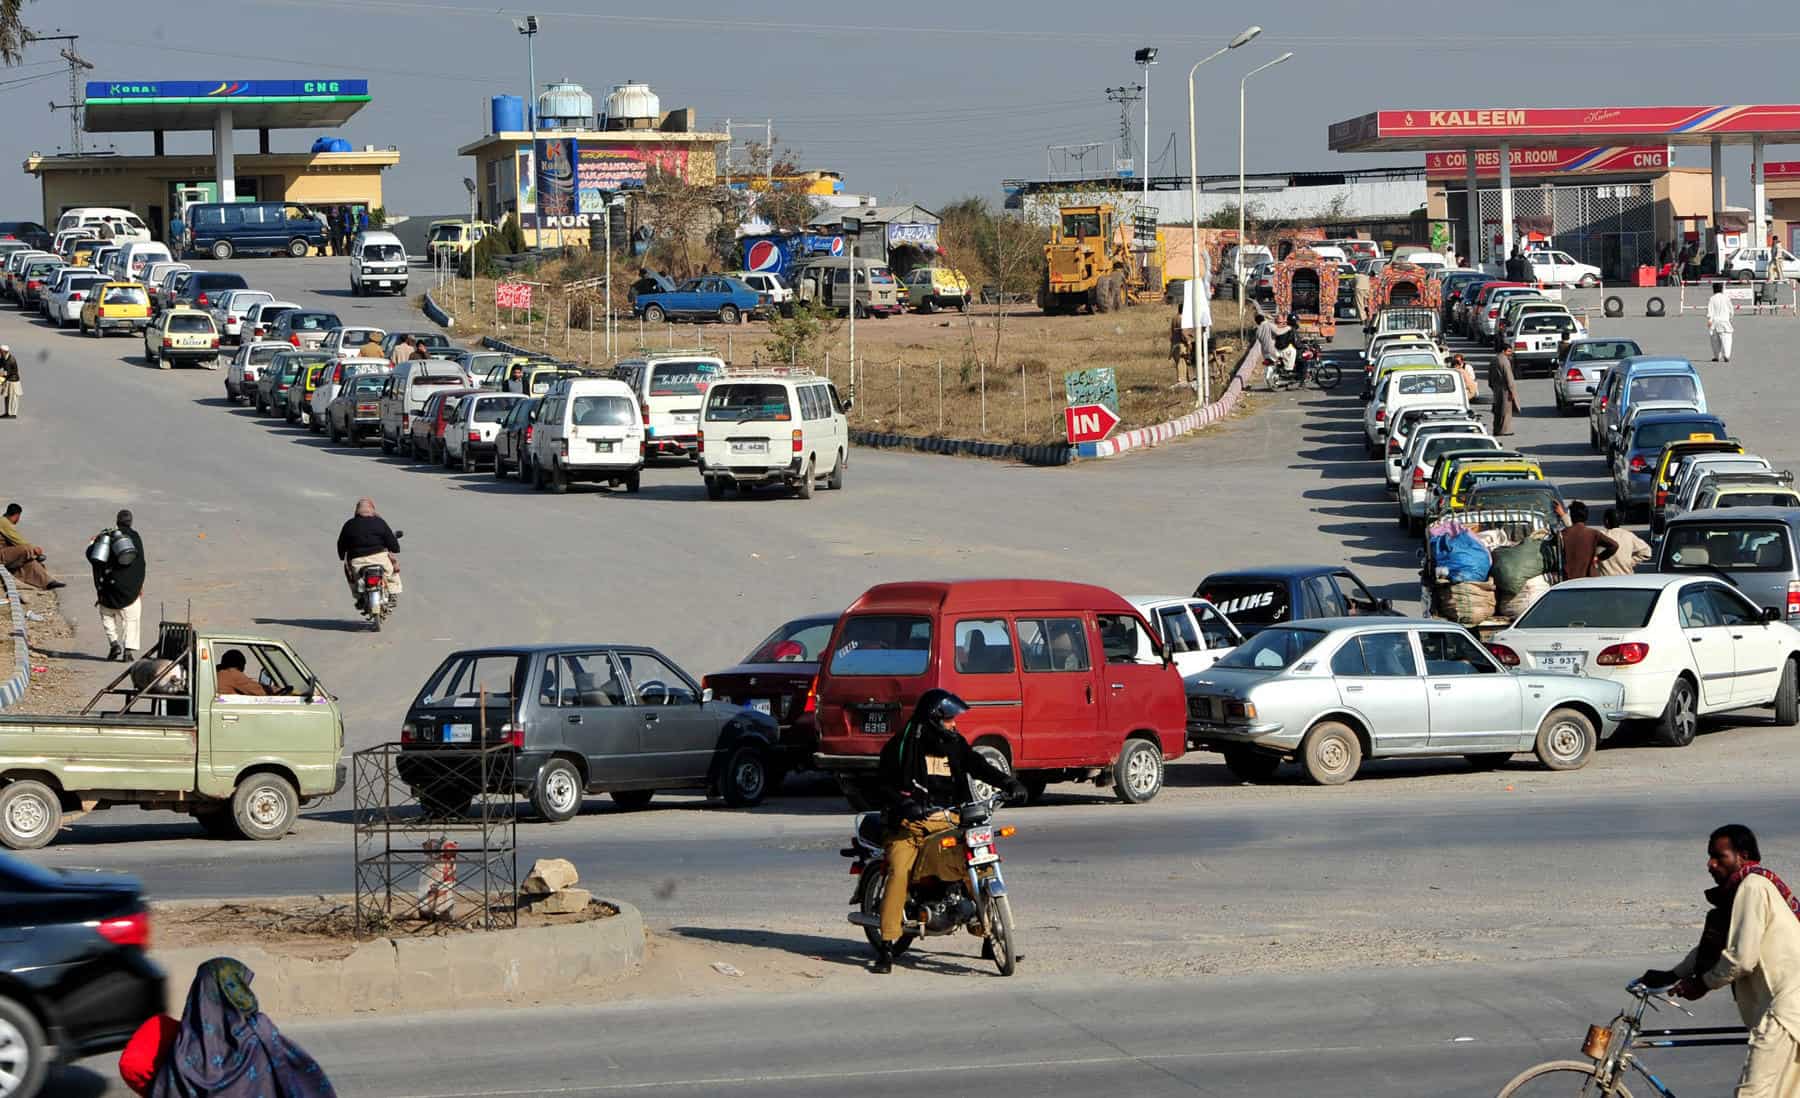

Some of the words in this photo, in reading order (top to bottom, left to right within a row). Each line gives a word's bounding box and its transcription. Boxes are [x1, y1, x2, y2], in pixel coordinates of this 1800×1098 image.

[304, 82, 340, 93] CNG
[1430, 111, 1525, 126] KALEEM
[1446, 152, 1522, 167] COMRESOR
[1525, 150, 1558, 164] ROOM
[1633, 153, 1662, 168] CNG
[1073, 413, 1100, 435] IN
[1214, 591, 1274, 616] ALIKS
[1541, 656, 1554, 665] JS
